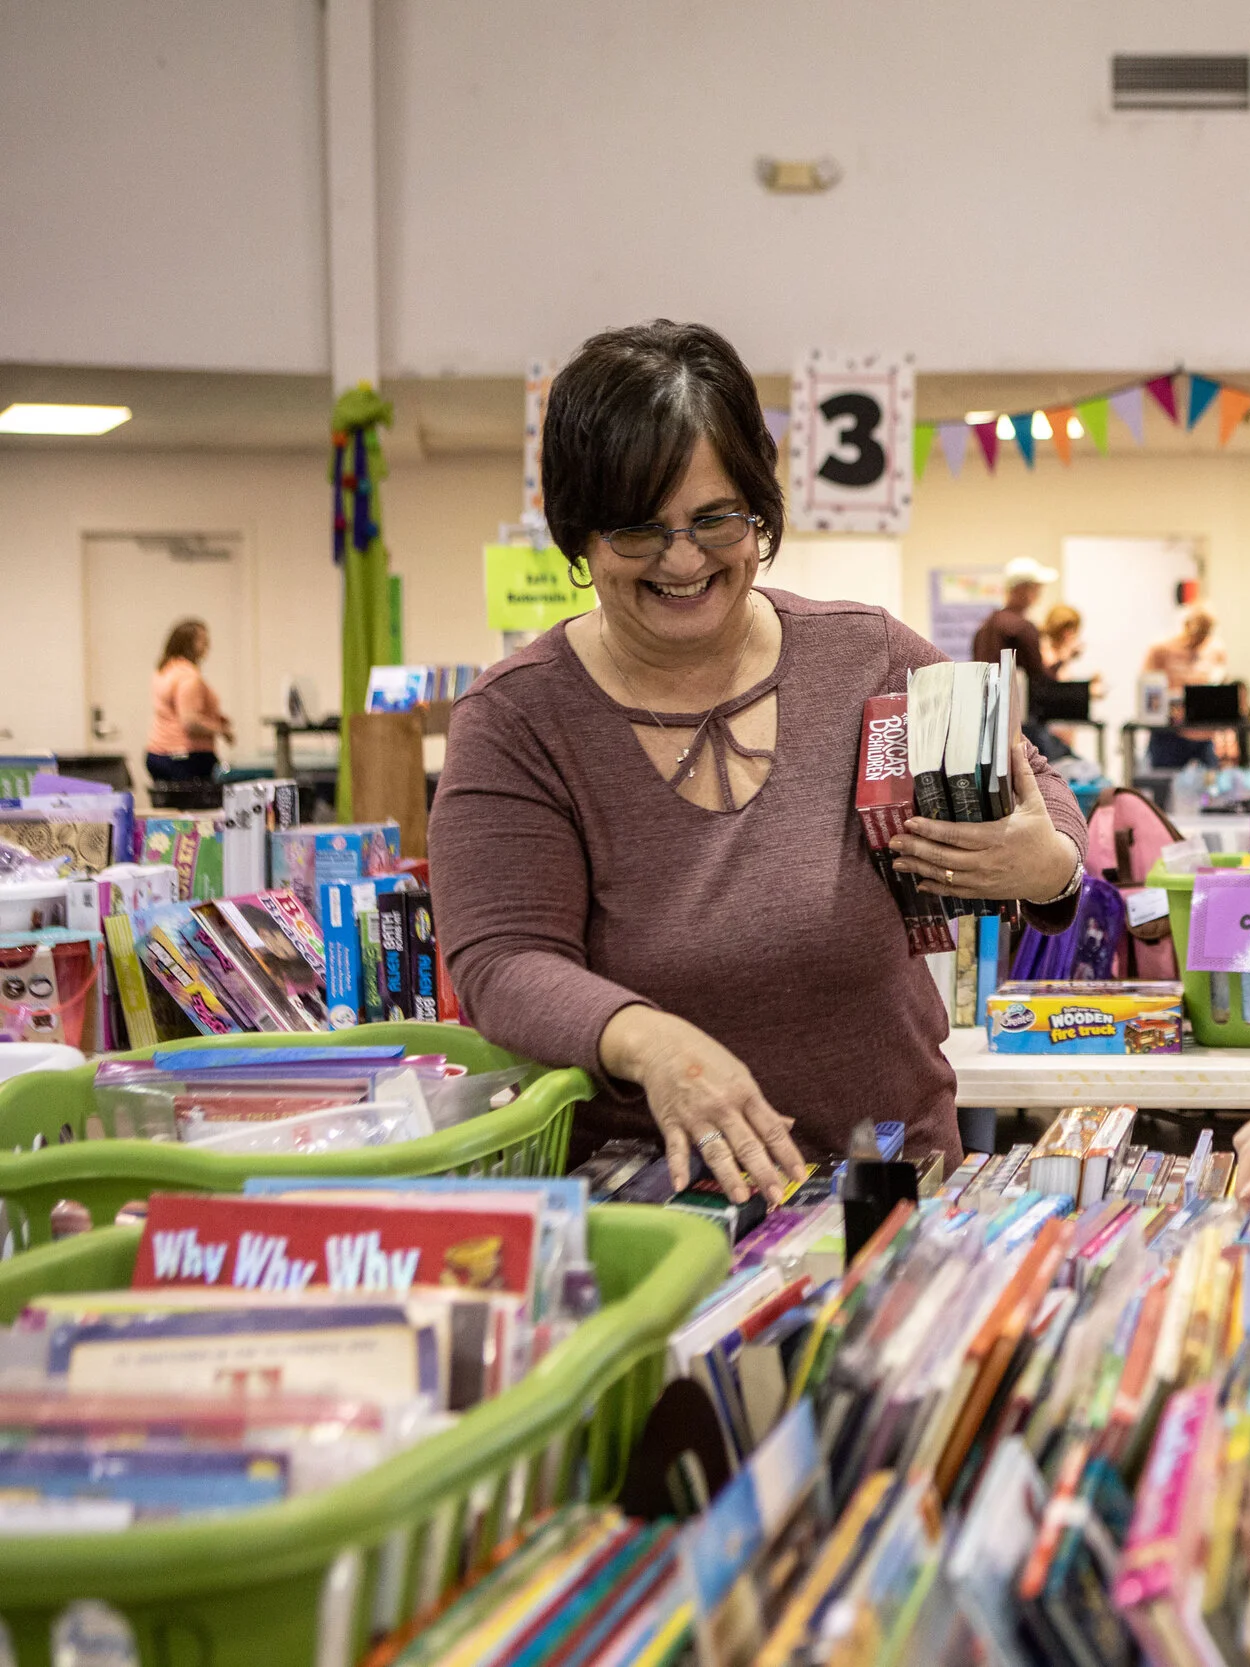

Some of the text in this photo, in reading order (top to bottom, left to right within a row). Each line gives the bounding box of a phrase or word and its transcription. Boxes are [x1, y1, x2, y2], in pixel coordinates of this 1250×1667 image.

[817, 392, 886, 488] 3
[865, 732, 886, 781] CHILDREN
[869, 714, 908, 780] BOXCAR
[380, 911, 400, 992] ALIEN BATH
[418, 954, 433, 996] ALIEN
[1051, 1013, 1115, 1028] WOODEN
[1051, 1024, 1117, 1042] fire truck
[153, 1229, 421, 1292] Why Why Why
